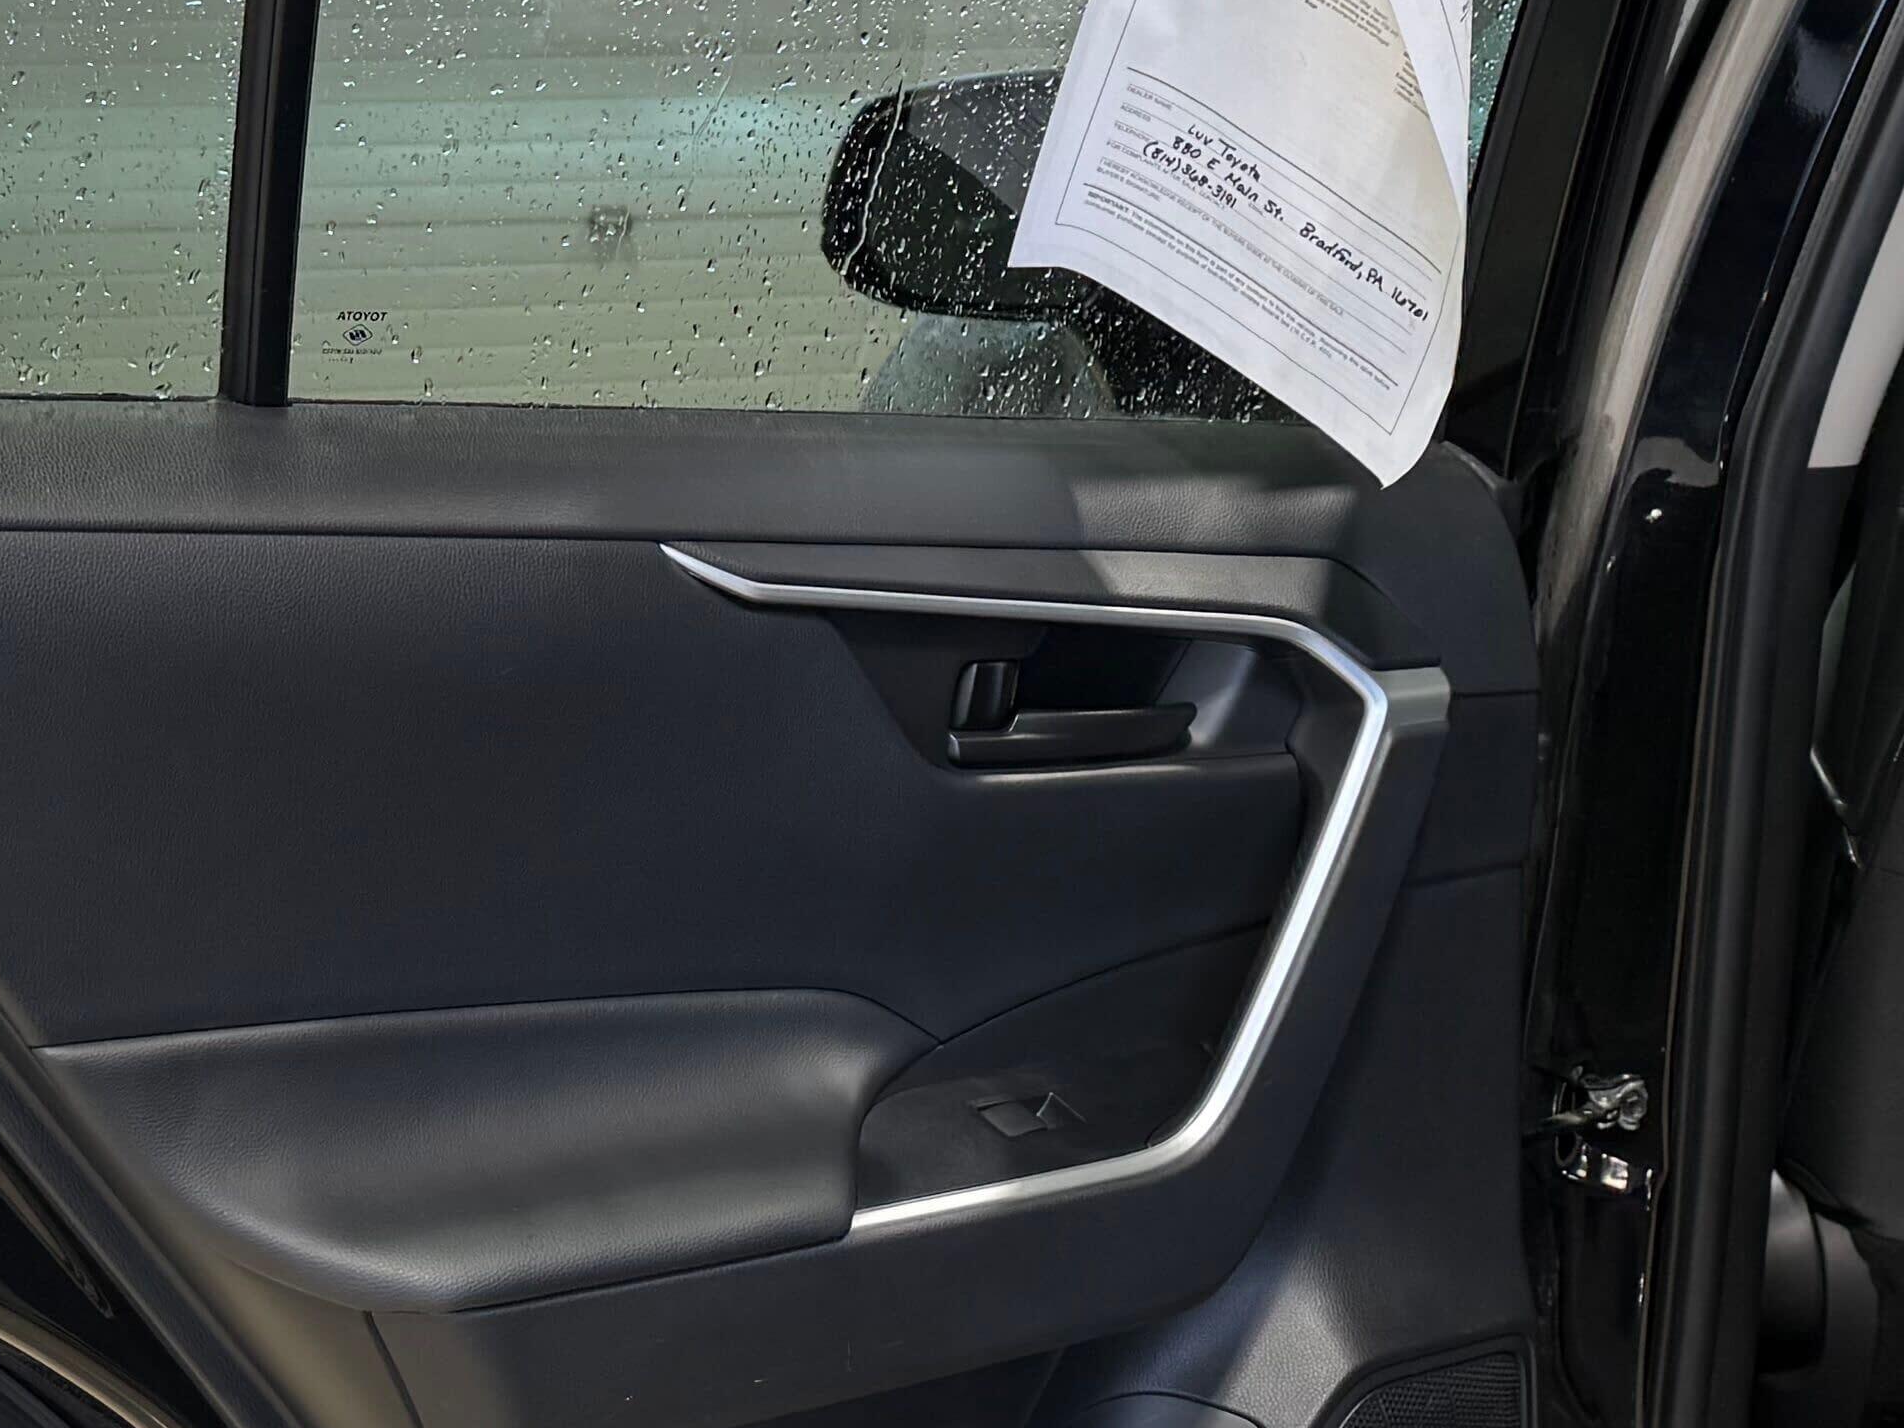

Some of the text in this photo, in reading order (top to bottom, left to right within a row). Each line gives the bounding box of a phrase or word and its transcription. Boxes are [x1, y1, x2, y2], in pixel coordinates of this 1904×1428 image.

[1214, 137, 1261, 183] Toyota
[1171, 135, 1202, 159] 880
[1206, 156, 1221, 170] E
[1223, 171, 1259, 202] Main
[1365, 267, 1383, 292] PA
